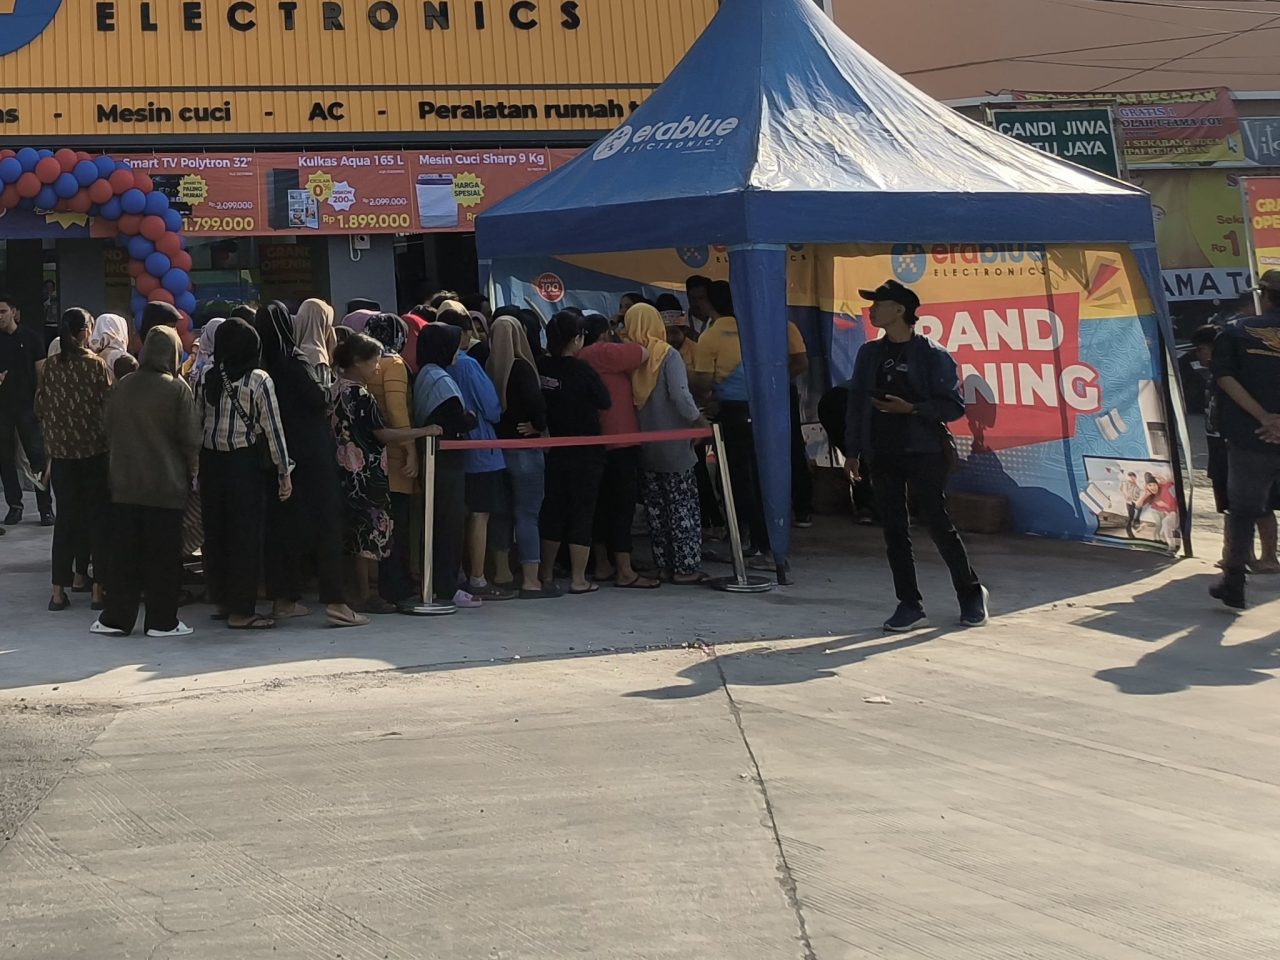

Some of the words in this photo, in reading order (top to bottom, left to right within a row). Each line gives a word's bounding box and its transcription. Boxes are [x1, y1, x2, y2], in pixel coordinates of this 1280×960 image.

[96, 0, 581, 32] ELECTRONICS
[97, 102, 171, 124] Mesin
[178, 101, 231, 122] cuci
[308, 101, 345, 121] AC
[418, 100, 541, 121] Peralatan
[544, 100, 624, 120] rumah
[632, 114, 739, 143] erablue
[998, 121, 1057, 137] CANDI
[1062, 120, 1109, 136] JIWA
[1063, 141, 1107, 156] JAYA
[161, 157, 177, 168] TV
[180, 157, 230, 170] Polytron
[298, 156, 337, 167] Kulkas
[340, 155, 371, 168] Aqua
[374, 155, 394, 166] 165
[397, 154, 404, 165] L
[419, 155, 453, 165] Mesin
[455, 155, 480, 165] Cuci
[482, 154, 516, 166] Sharp
[518, 153, 526, 163] 9
[529, 153, 544, 165] Kg
[182, 217, 254, 231] 1.799.000
[322, 215, 335, 224] Rp
[337, 213, 410, 228] 1.899.000
[933, 266, 1047, 277] ELECTRONICS
[1161, 272, 1222, 297] AMA
